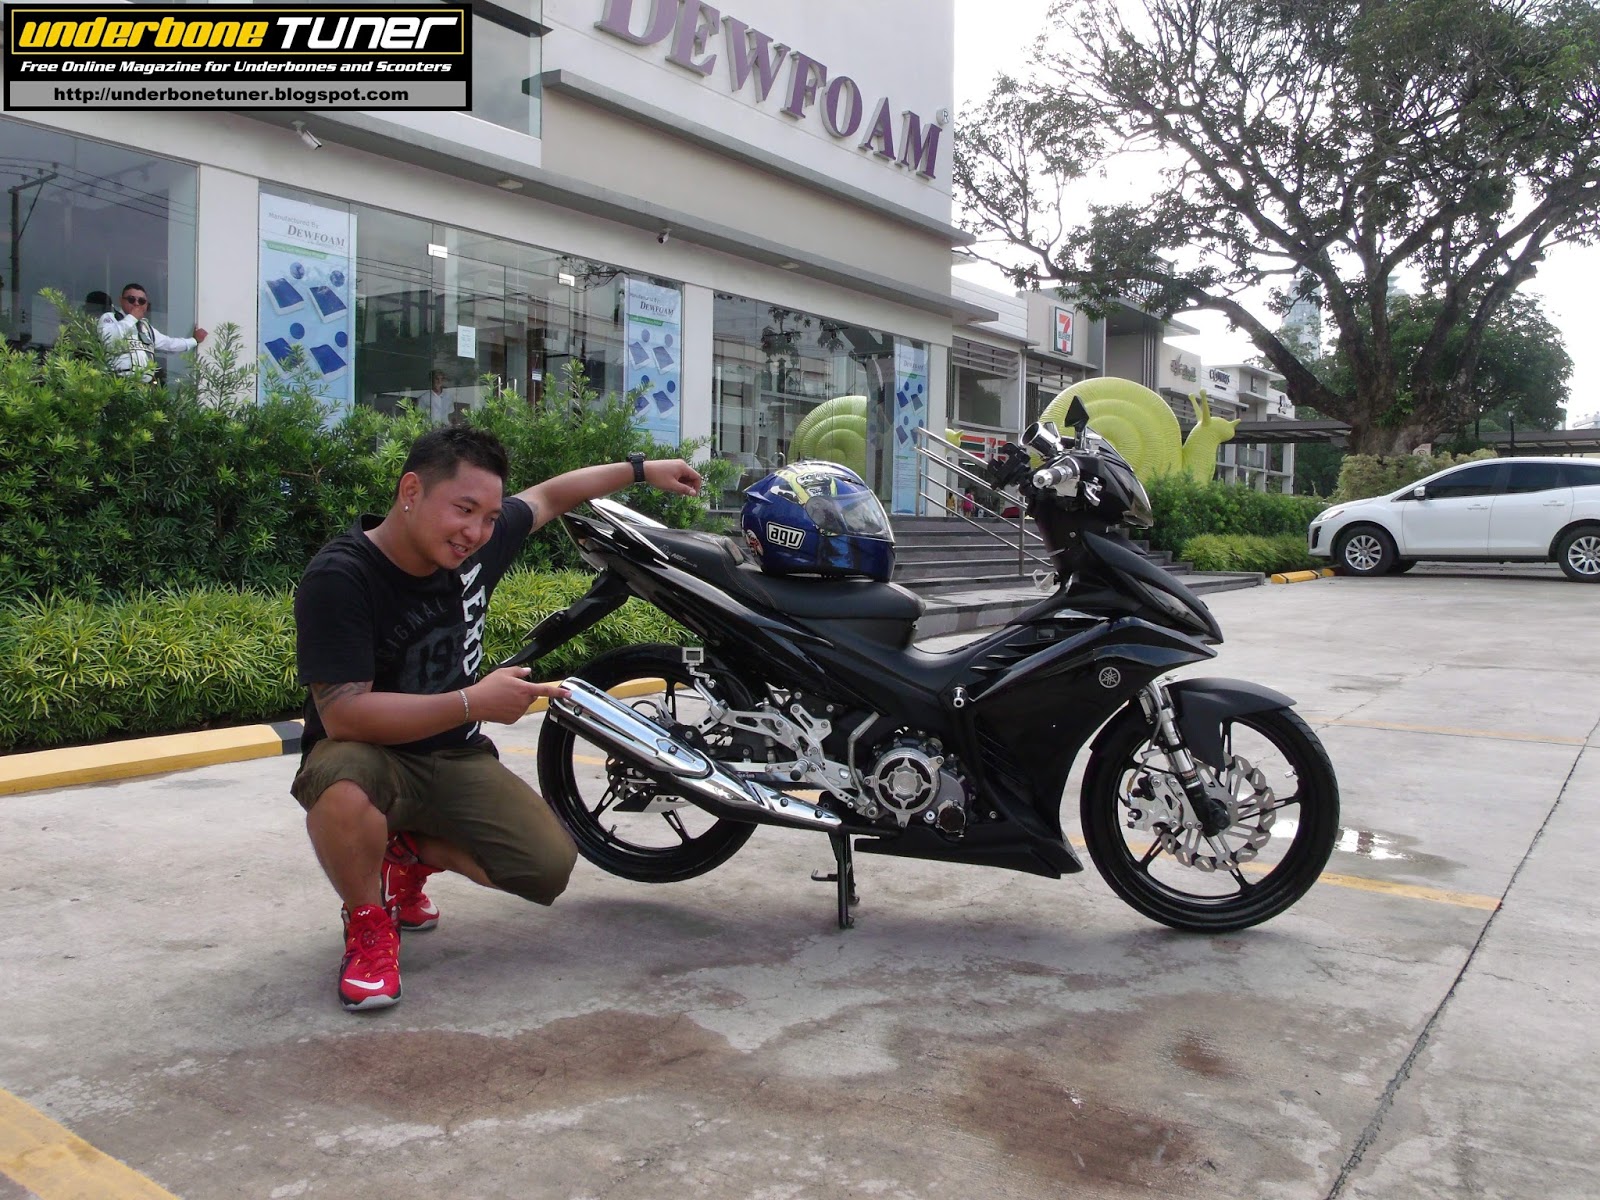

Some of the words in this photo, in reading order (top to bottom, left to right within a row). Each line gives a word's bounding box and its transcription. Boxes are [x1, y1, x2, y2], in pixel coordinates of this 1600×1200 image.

[594, 0, 942, 180] DEWFOAM
[287, 224, 345, 247] DEWFOAM
[770, 527, 800, 546] agv
[460, 562, 487, 677] AERO
